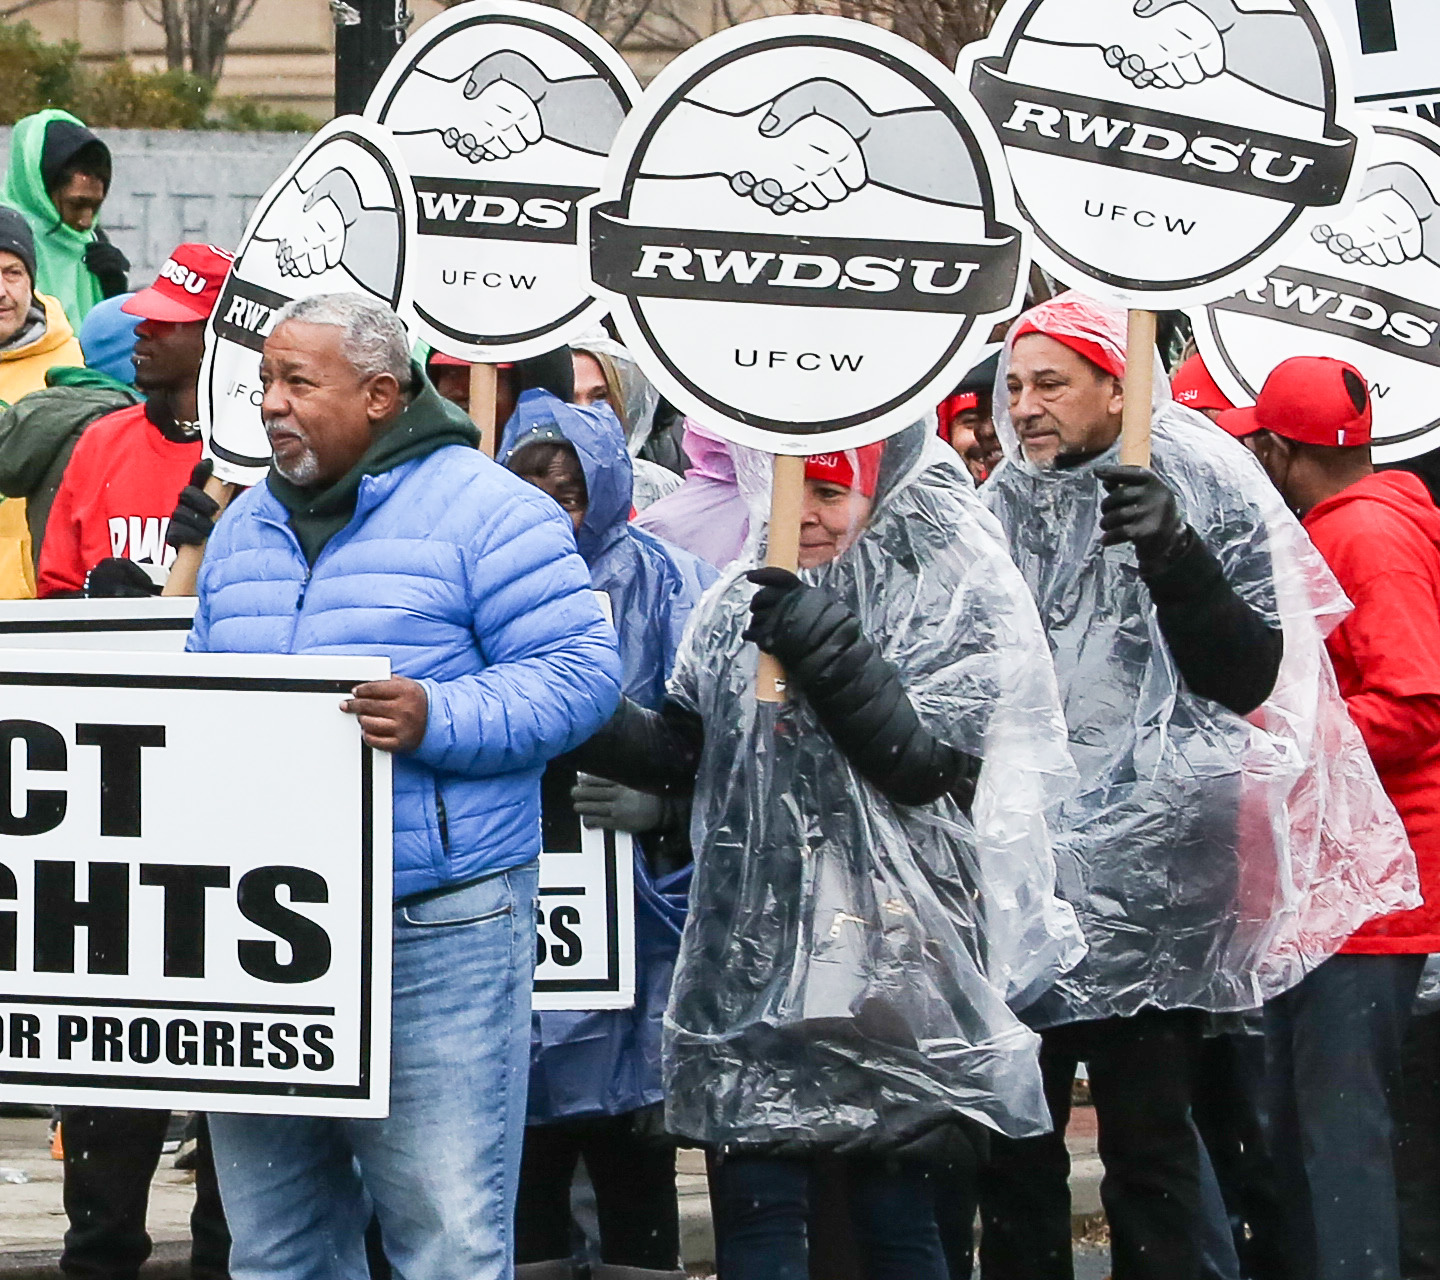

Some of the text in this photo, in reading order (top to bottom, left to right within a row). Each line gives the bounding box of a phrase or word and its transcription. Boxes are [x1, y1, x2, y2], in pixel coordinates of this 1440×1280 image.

[1002, 99, 1315, 184] RWDSU
[1084, 199, 1197, 236] UFCW
[442, 269, 536, 290] UFCW
[632, 244, 979, 295] RWDSU
[735, 348, 864, 373] UFCW
[58, 1015, 335, 1071] PROGRESS
